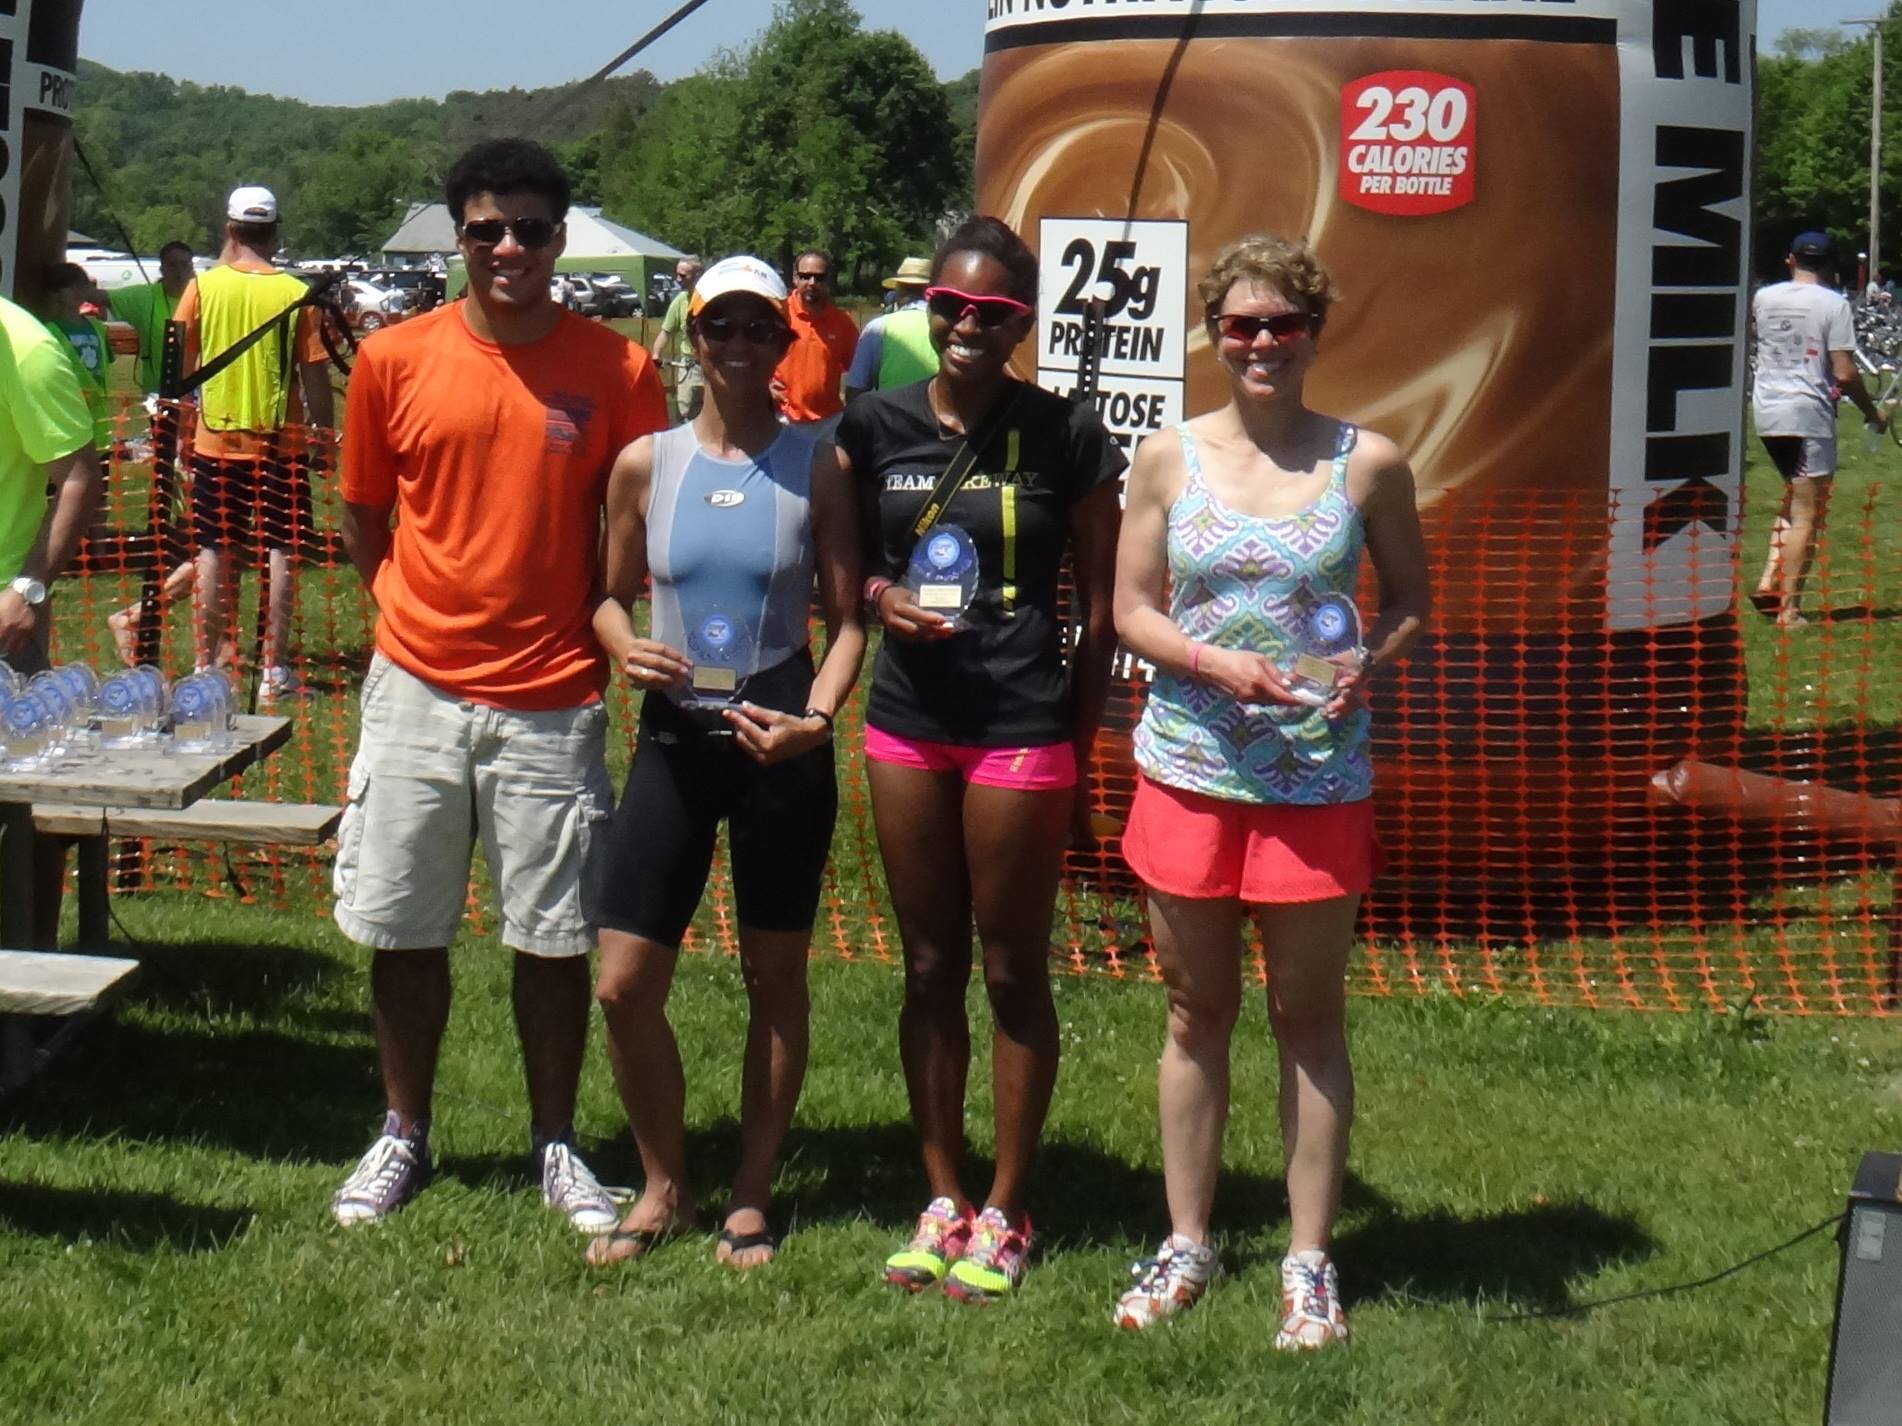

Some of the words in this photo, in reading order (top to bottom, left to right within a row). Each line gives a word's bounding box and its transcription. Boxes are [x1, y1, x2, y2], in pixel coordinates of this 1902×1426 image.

[1348, 86, 1467, 142] 230
[1347, 144, 1468, 175] CALORIES
[1360, 175, 1392, 194] PER
[1395, 176, 1453, 195] BOTTLE
[1053, 238, 1162, 321] 25g
[1048, 320, 1165, 362] PRTEIN
[1642, 125, 1745, 556] MILK
[886, 473, 936, 491] TEAM
[914, 502, 940, 537] Nikon
